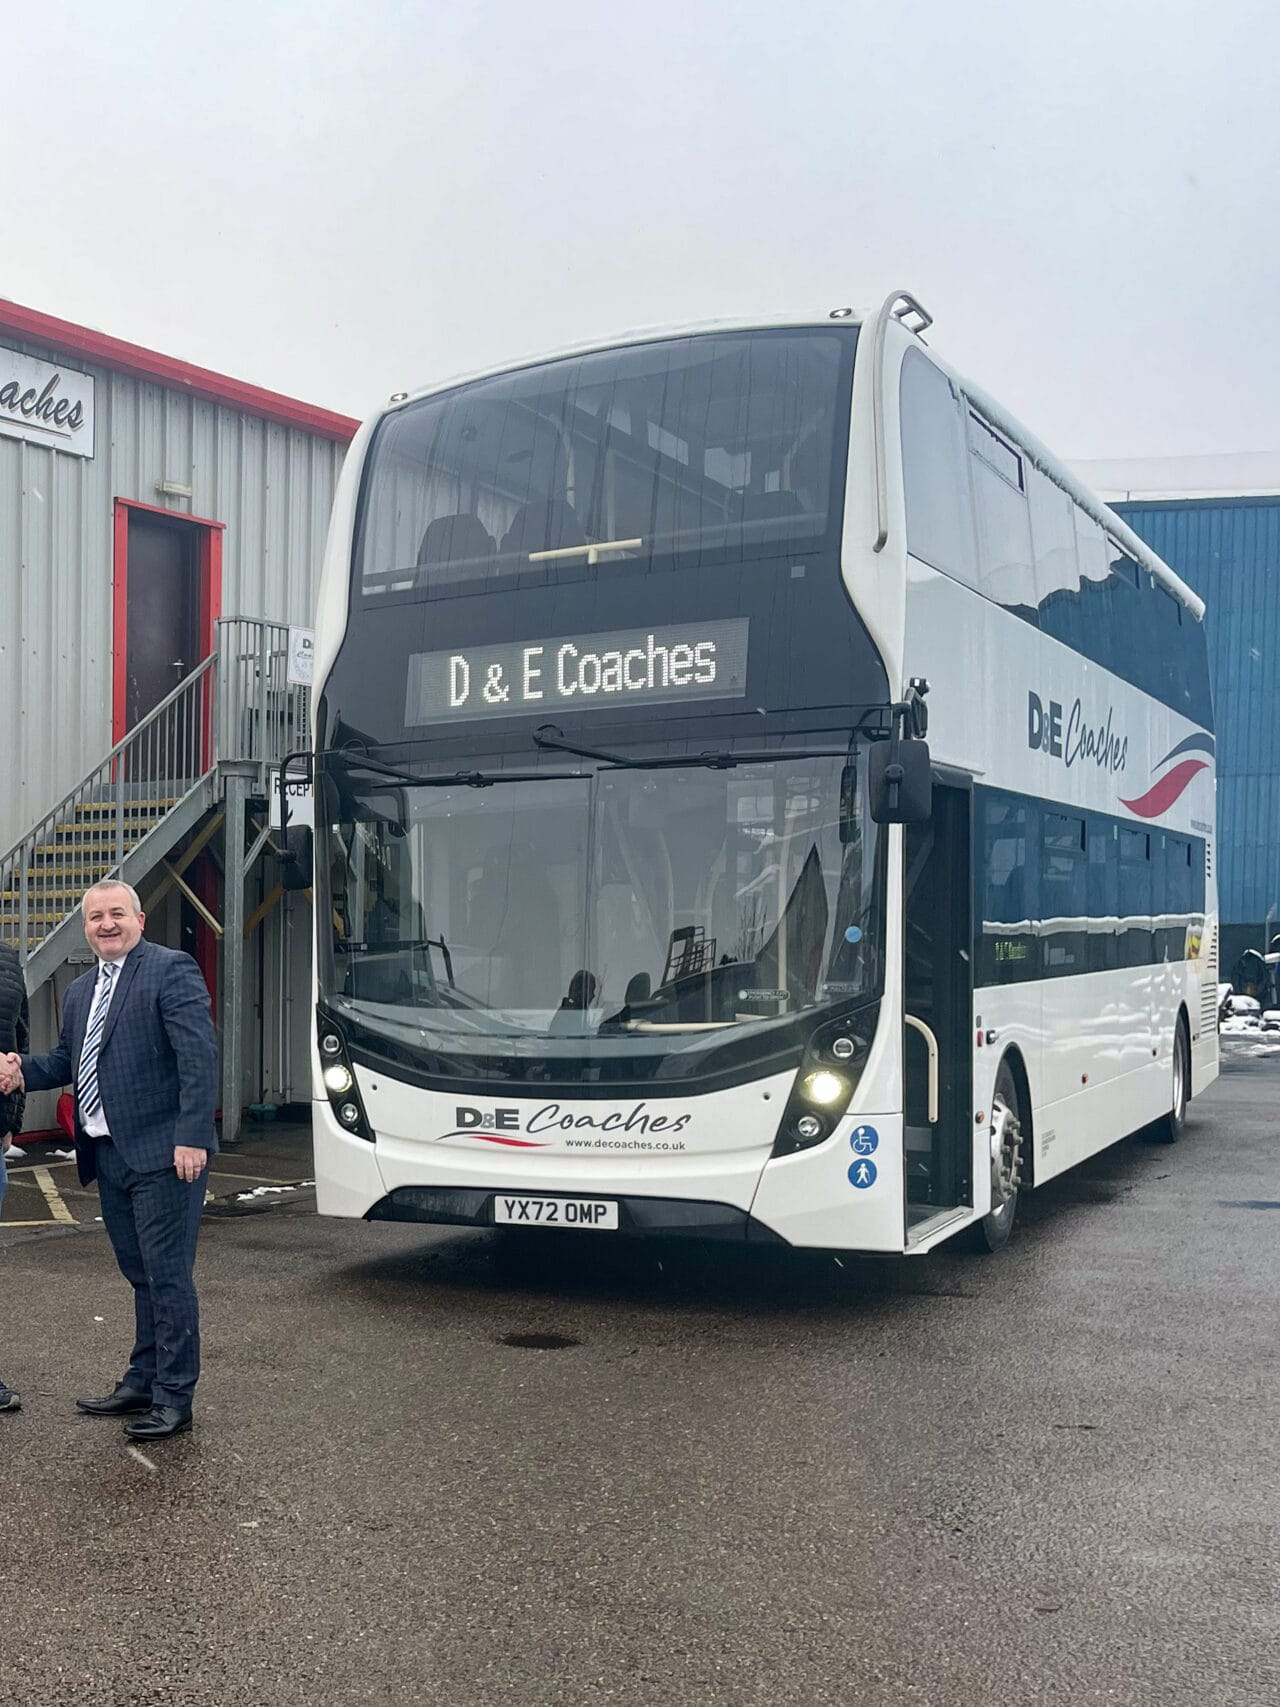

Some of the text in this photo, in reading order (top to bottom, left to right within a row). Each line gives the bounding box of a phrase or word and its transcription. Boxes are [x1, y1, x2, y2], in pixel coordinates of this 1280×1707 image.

[449, 634, 717, 707] D & E Coaches
[1028, 690, 1129, 775] D&E Coaches
[456, 1102, 692, 1135] D&E Coaches
[565, 1138, 686, 1151] www.decoaches.co.uk
[504, 1200, 607, 1224] YX72 OMP
